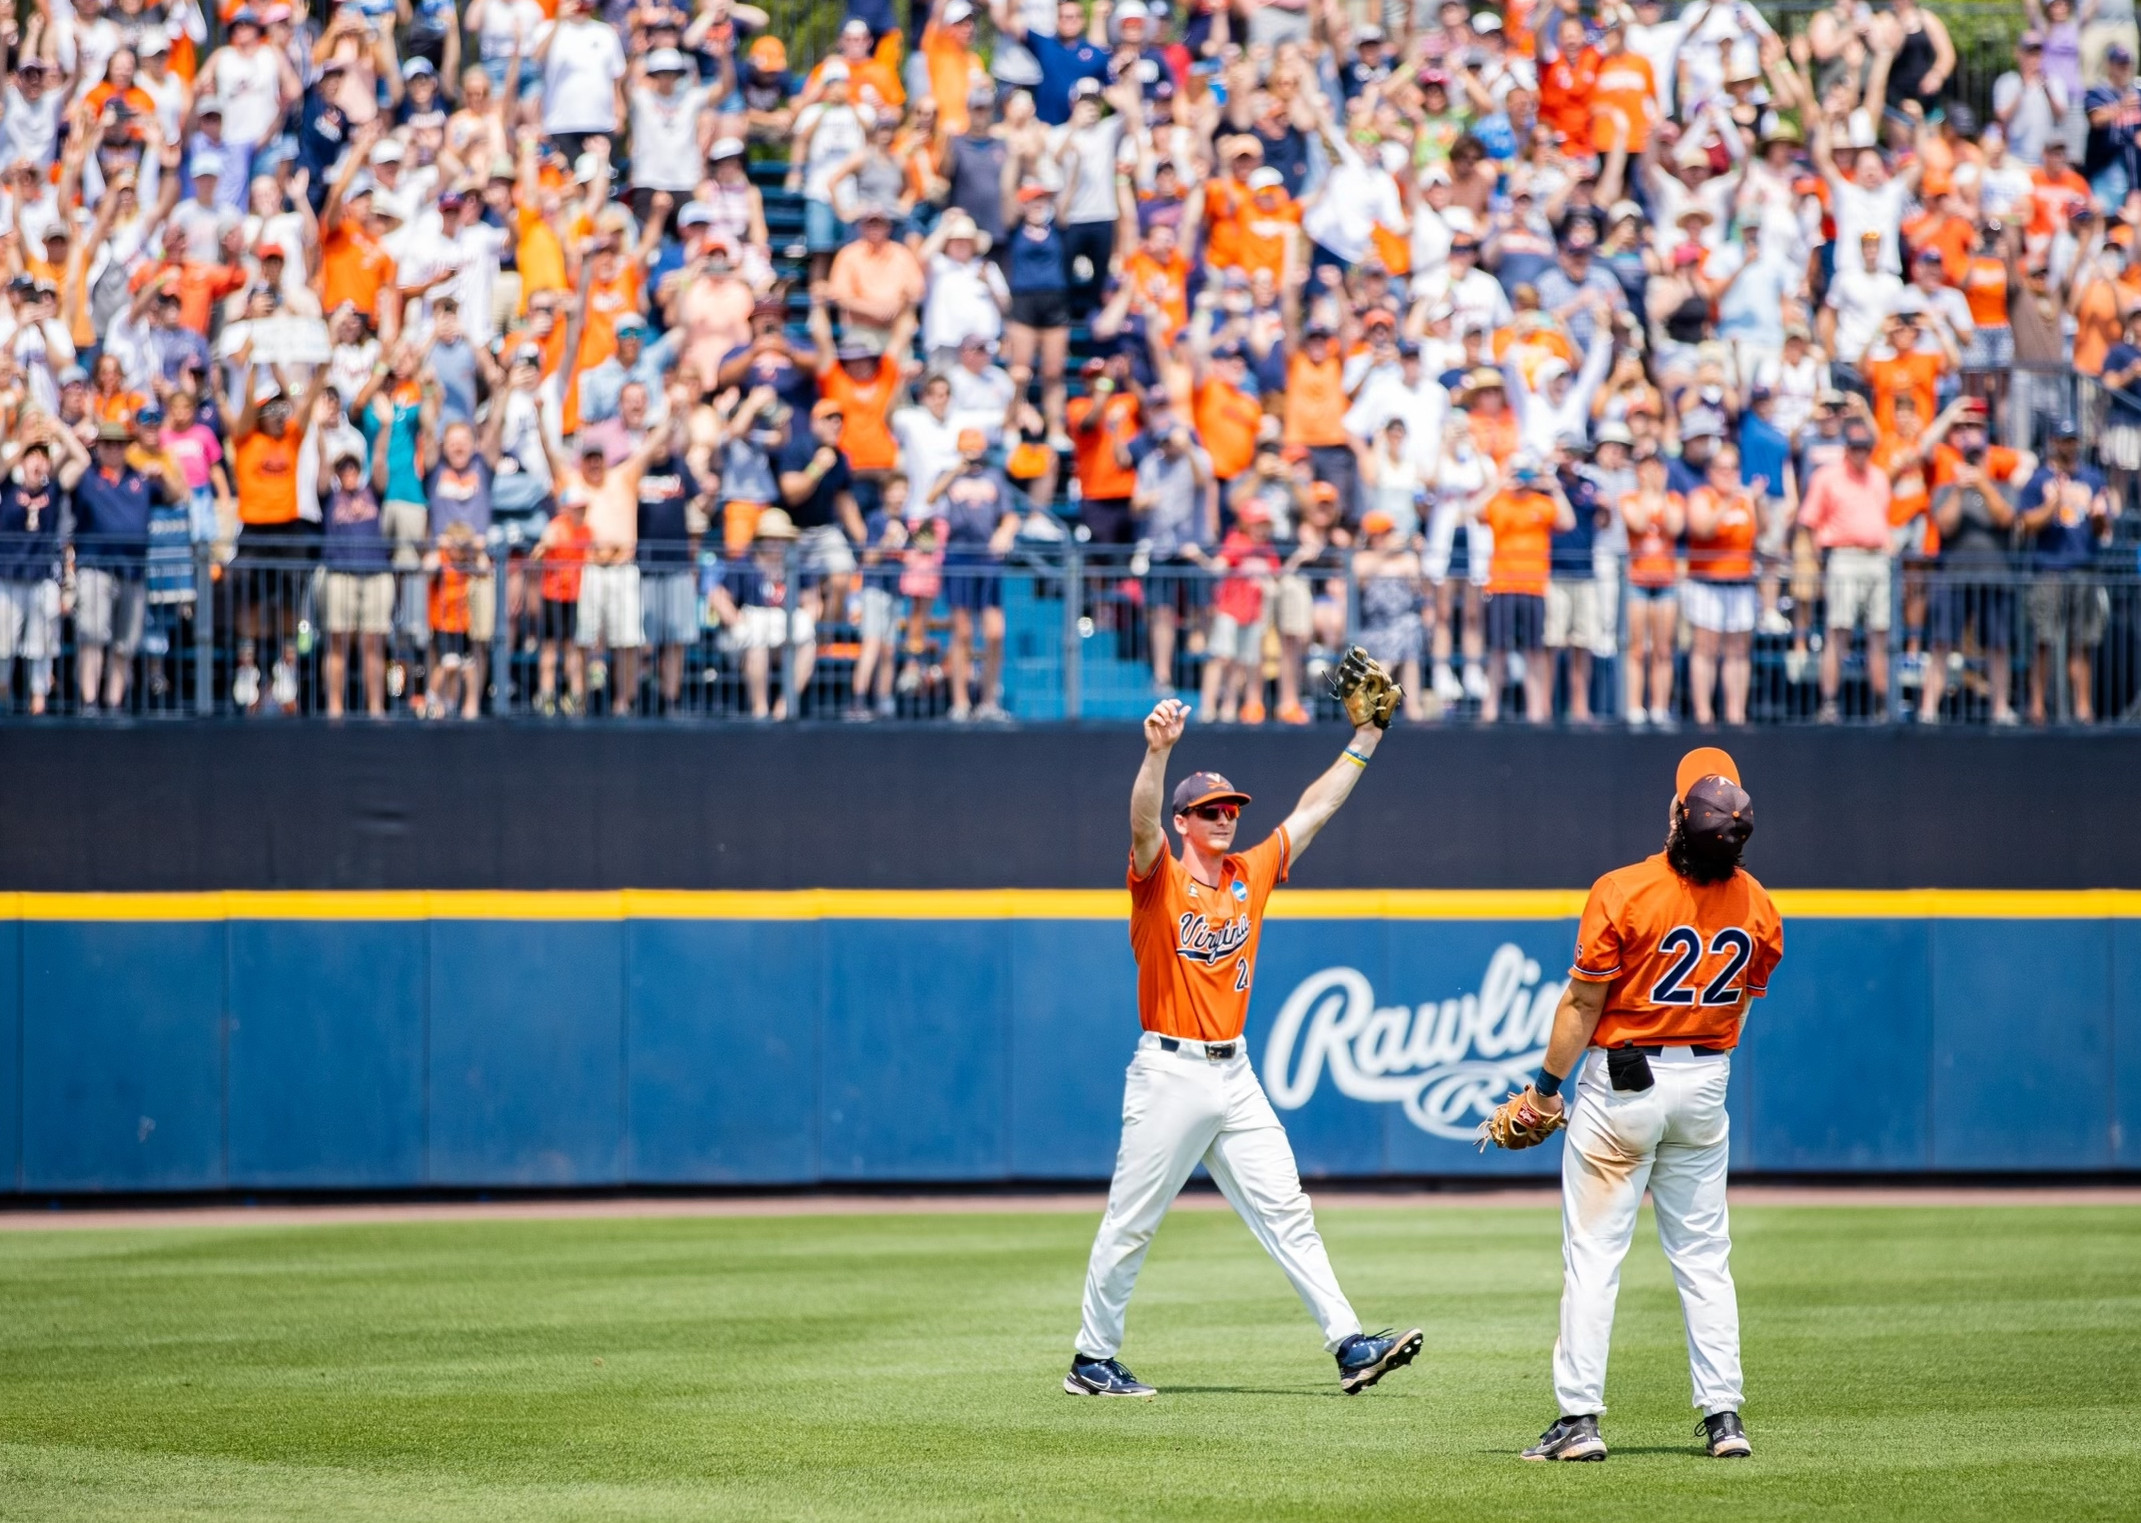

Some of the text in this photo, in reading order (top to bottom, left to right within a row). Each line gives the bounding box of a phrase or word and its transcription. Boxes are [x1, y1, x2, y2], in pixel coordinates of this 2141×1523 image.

[1234, 957, 1250, 992] 2
[1650, 924, 1753, 1006] 22
[1264, 943, 1570, 1110] Rawlin
